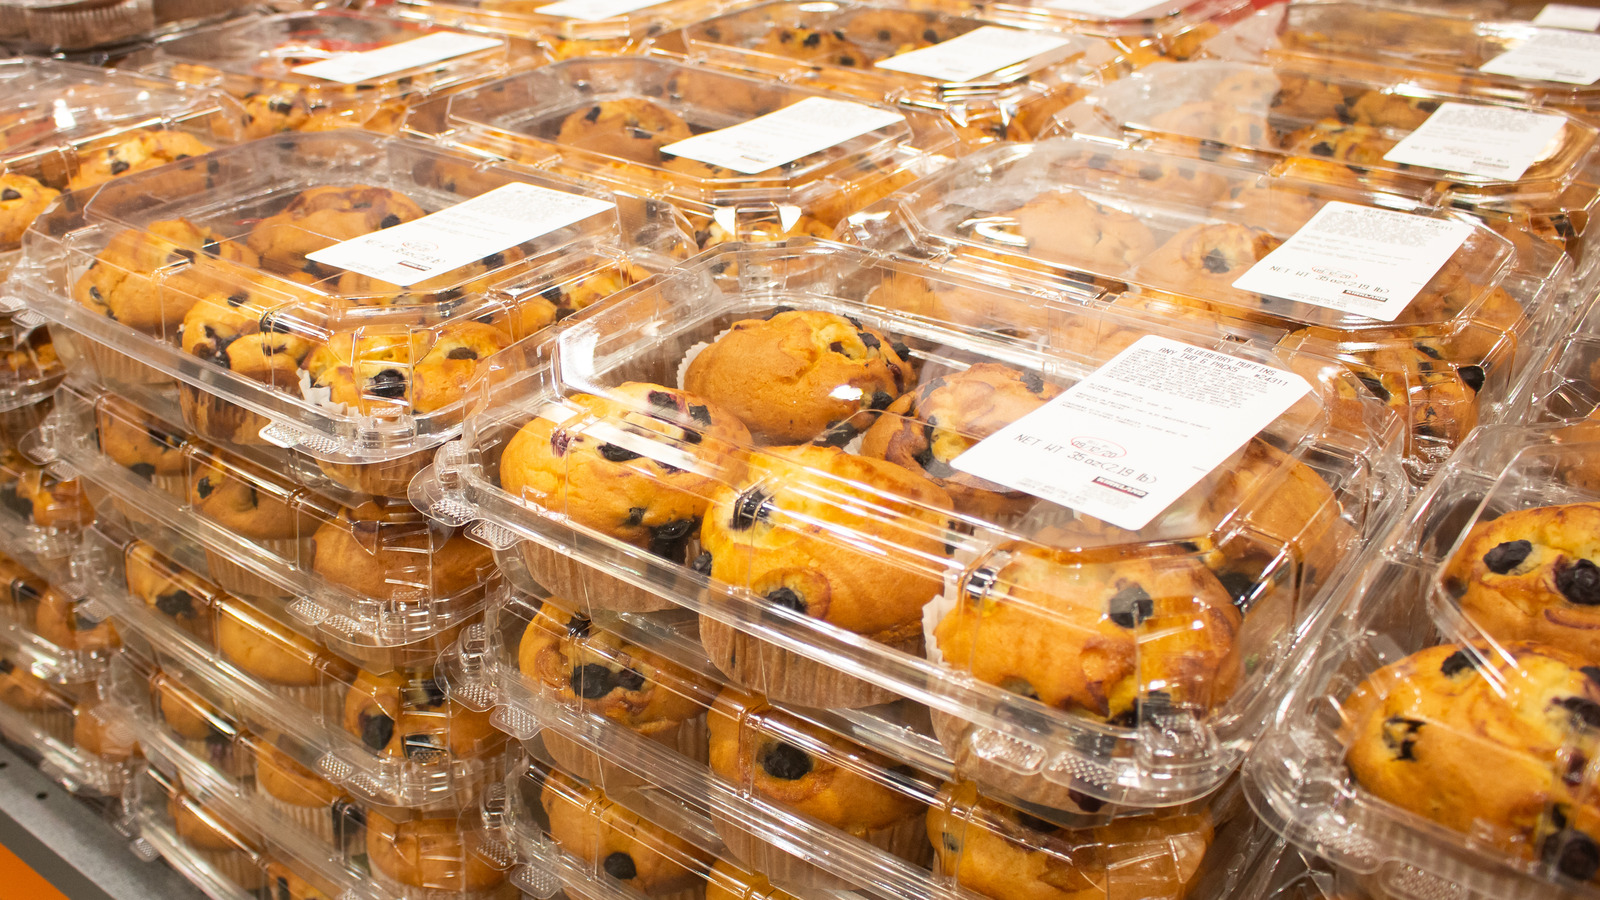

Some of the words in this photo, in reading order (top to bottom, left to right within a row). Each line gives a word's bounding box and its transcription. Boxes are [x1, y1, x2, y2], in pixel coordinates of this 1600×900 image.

[1158, 347, 1177, 355] ANY
[1180, 352, 1198, 361] TWO
[1211, 361, 1240, 373] PACKS
[1183, 346, 1234, 365] BLUEBERRY
[1236, 360, 1277, 376] MUFFINS
[1254, 374, 1289, 387] #24311
[1014, 434, 1042, 446] NET
[1044, 443, 1065, 454] WT
[1136, 472, 1157, 484] lb)
[1096, 476, 1147, 498] KIRKLAND
